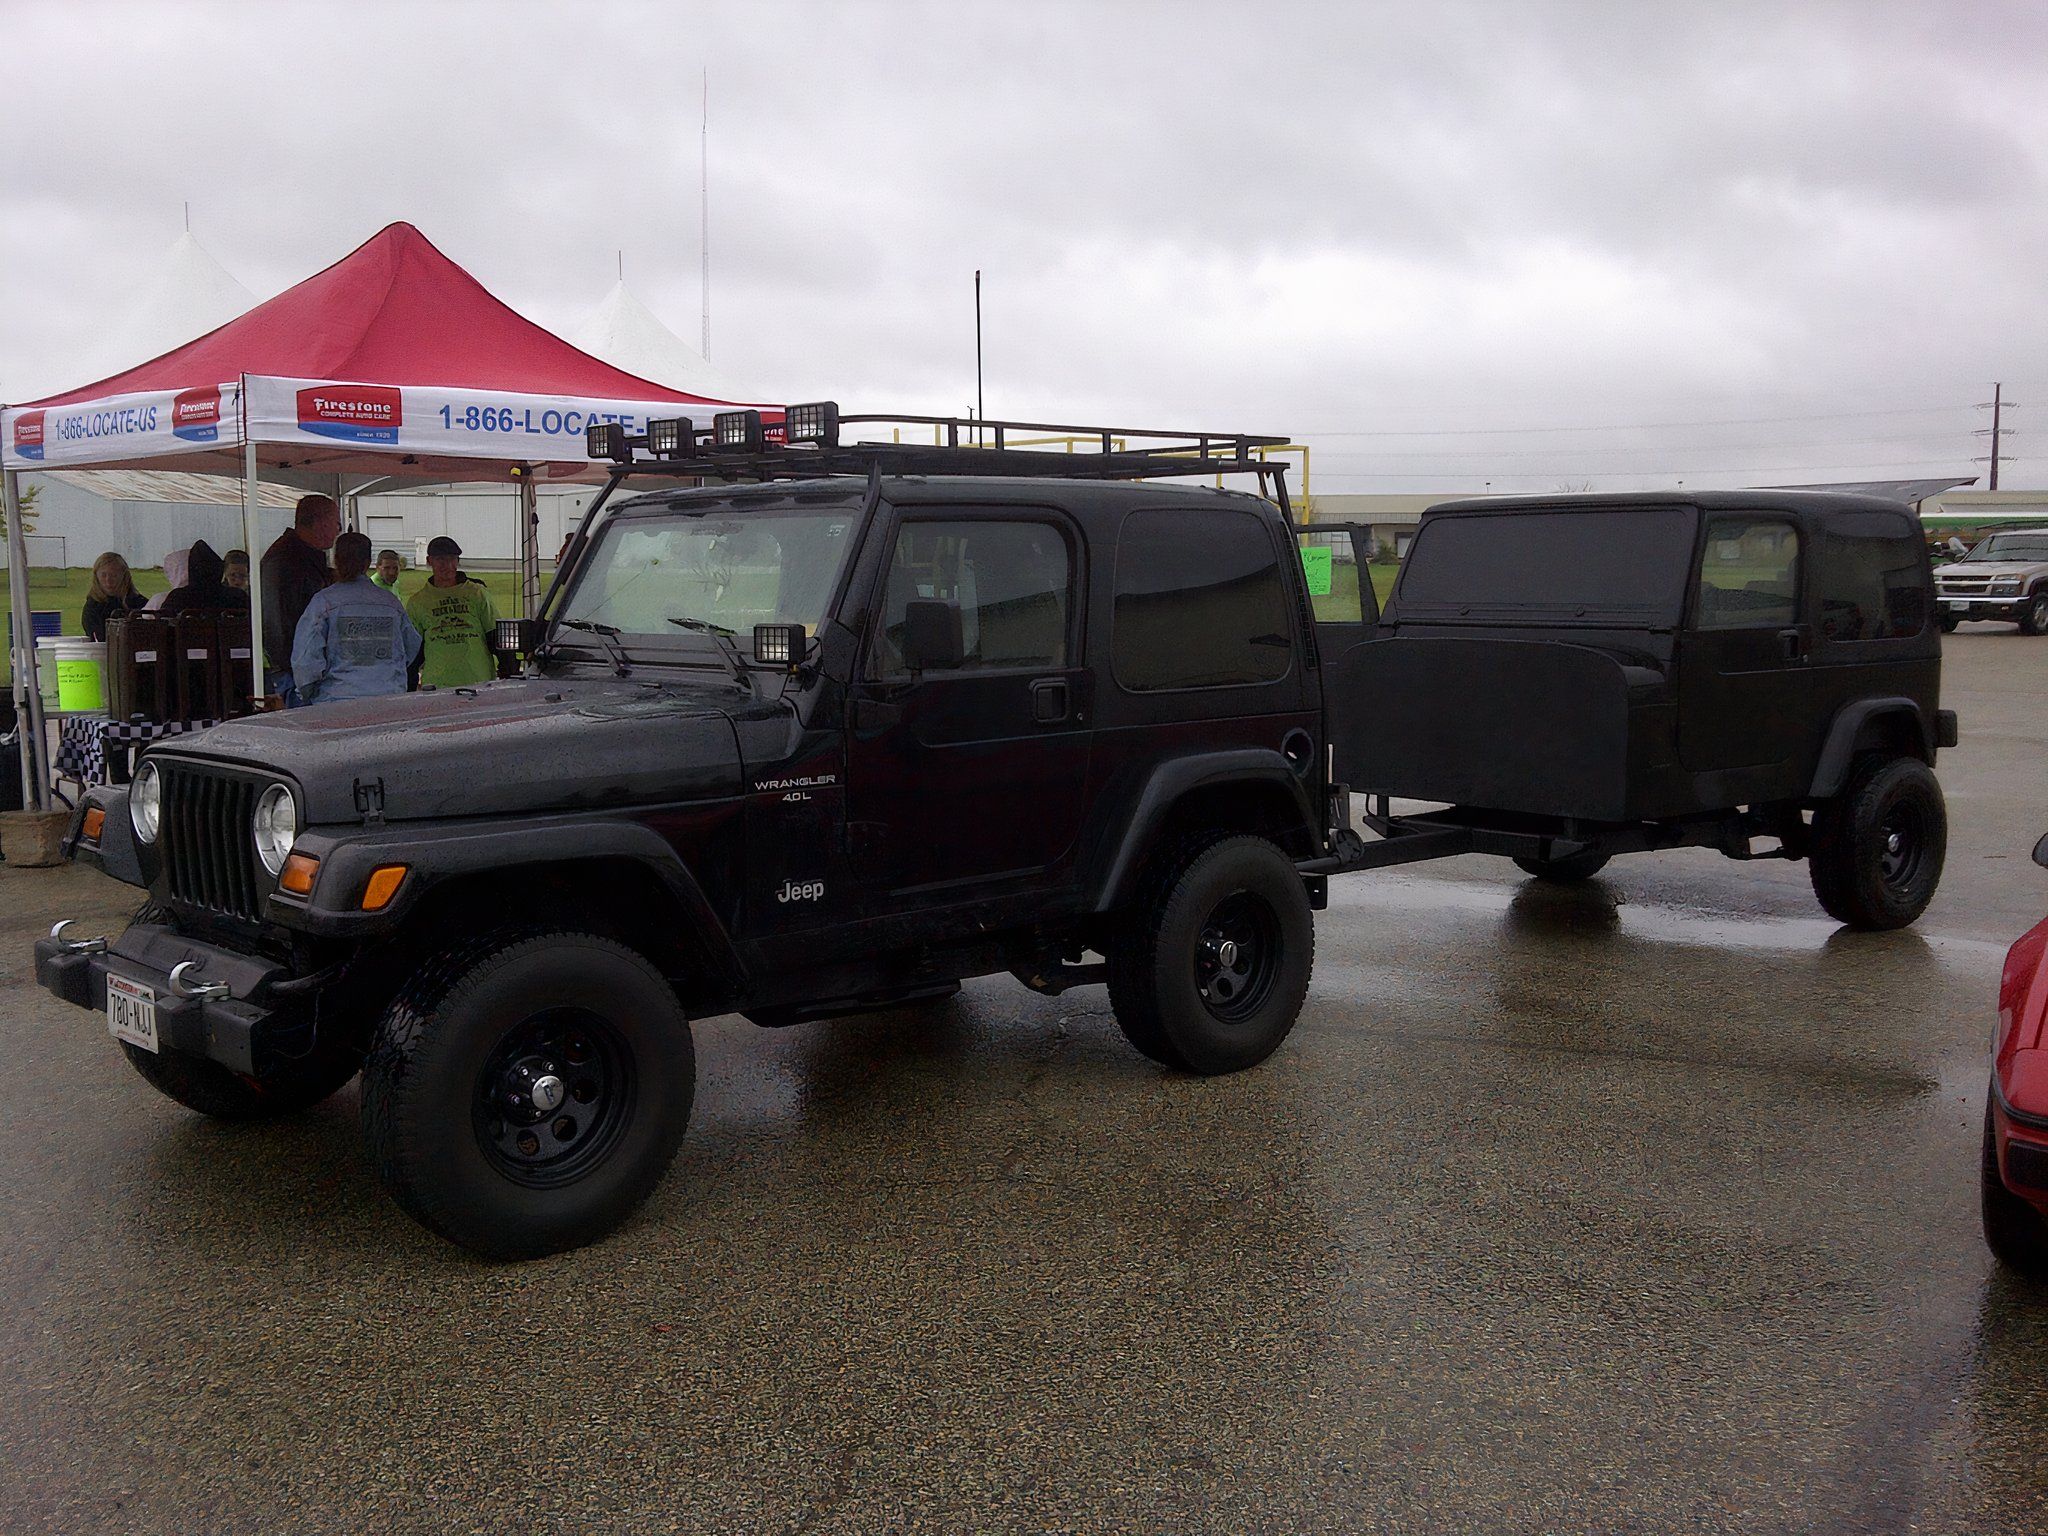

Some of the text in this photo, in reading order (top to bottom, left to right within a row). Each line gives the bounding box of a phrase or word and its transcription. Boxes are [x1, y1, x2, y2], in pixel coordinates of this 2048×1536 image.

[313, 397, 391, 413] Firestone
[320, 410, 354, 418] COMPLETE
[55, 406, 157, 440] 1-866-LOCATE-US
[439, 404, 652, 436] 1-866-LOCATE-
[755, 775, 836, 790] WRANGLER
[777, 881, 825, 903] Jeep
